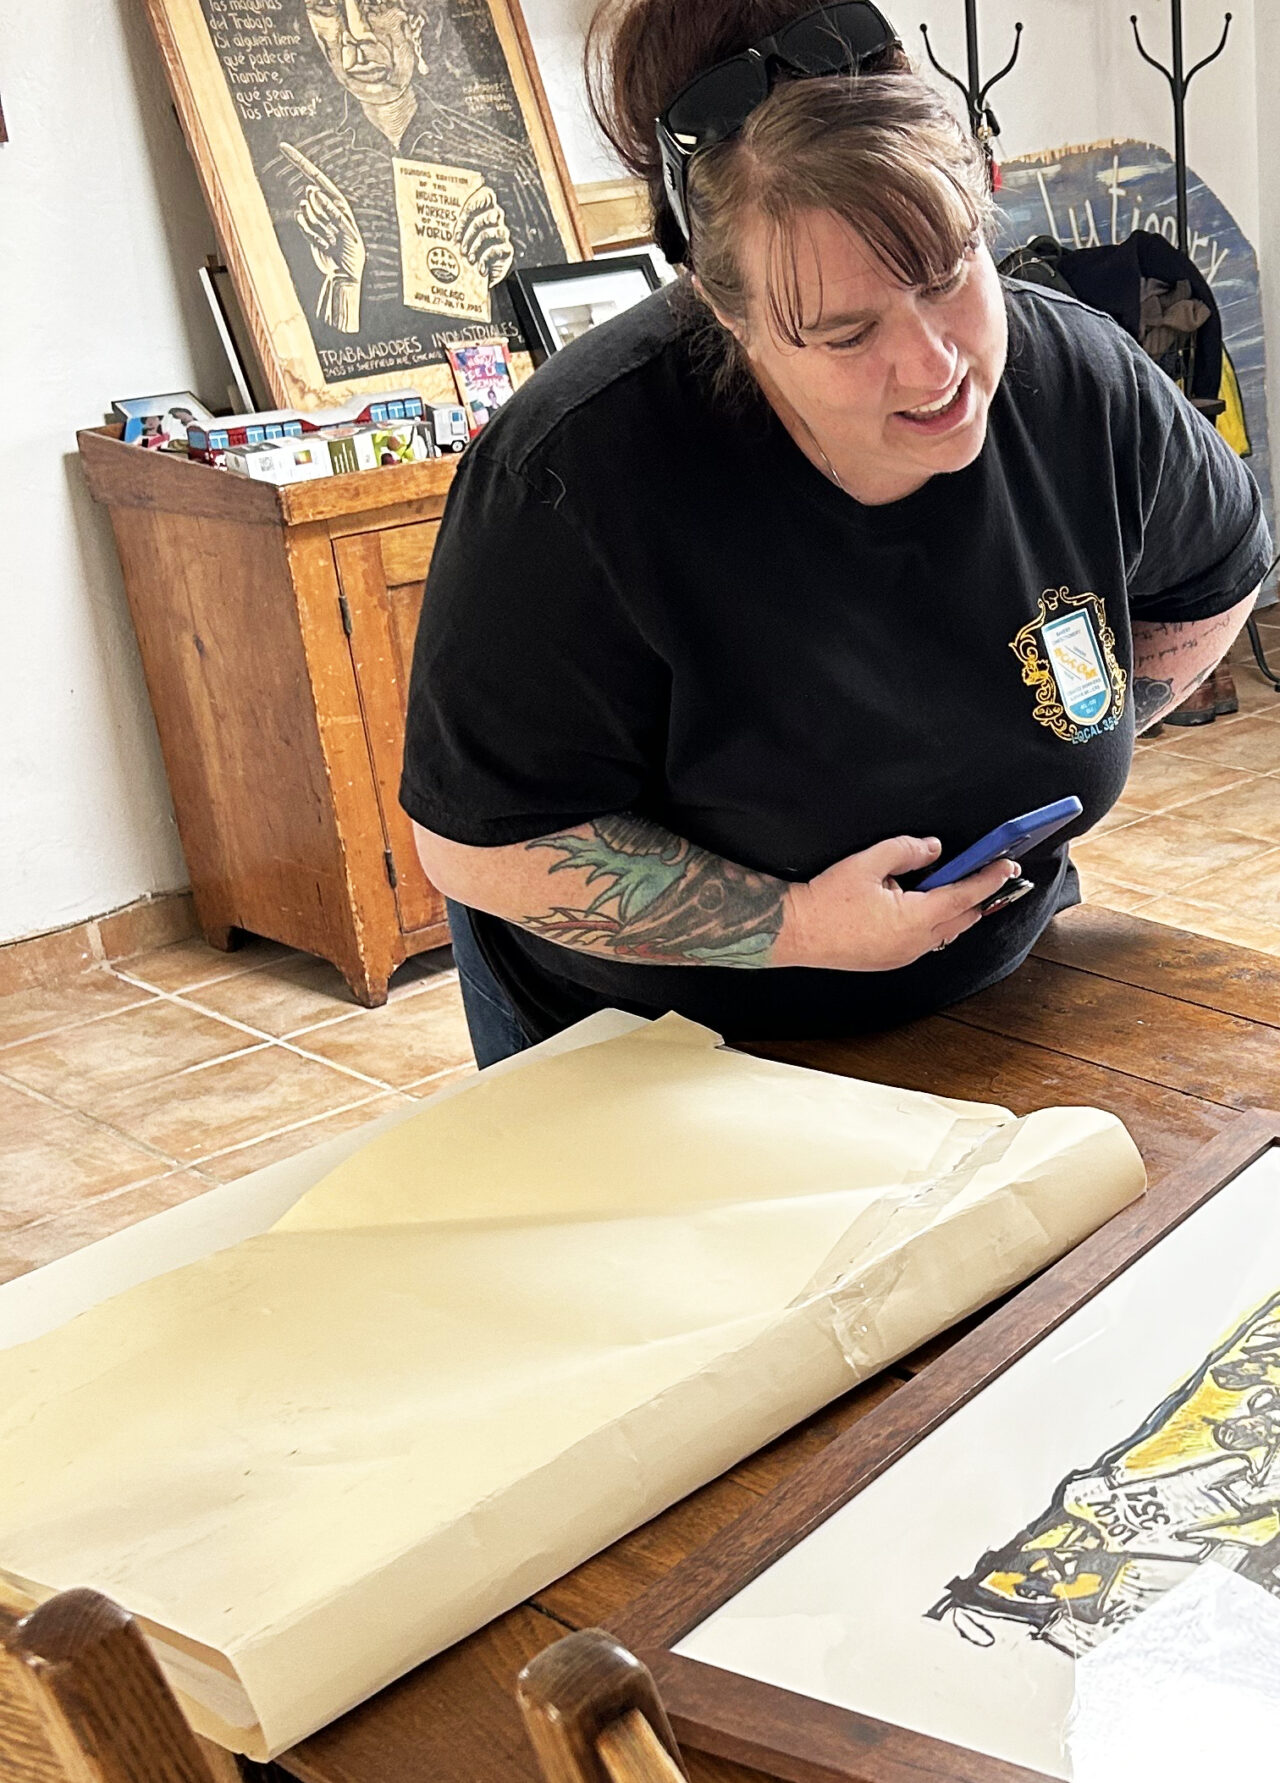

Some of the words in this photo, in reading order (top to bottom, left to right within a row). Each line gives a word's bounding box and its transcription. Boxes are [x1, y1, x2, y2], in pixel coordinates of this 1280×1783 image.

[209, 14, 229, 30] del
[265, 89, 295, 102] sean
[239, 104, 262, 120] los
[415, 190, 461, 207] INDUSTRIAL
[416, 202, 457, 221] WORKERS
[415, 223, 453, 241] WORLD
[431, 285, 465, 301] CHICAGO
[319, 335, 422, 367] TRABAJADORES
[1071, 725, 1103, 745] LOCAL
[1123, 1485, 1171, 1531] 351
